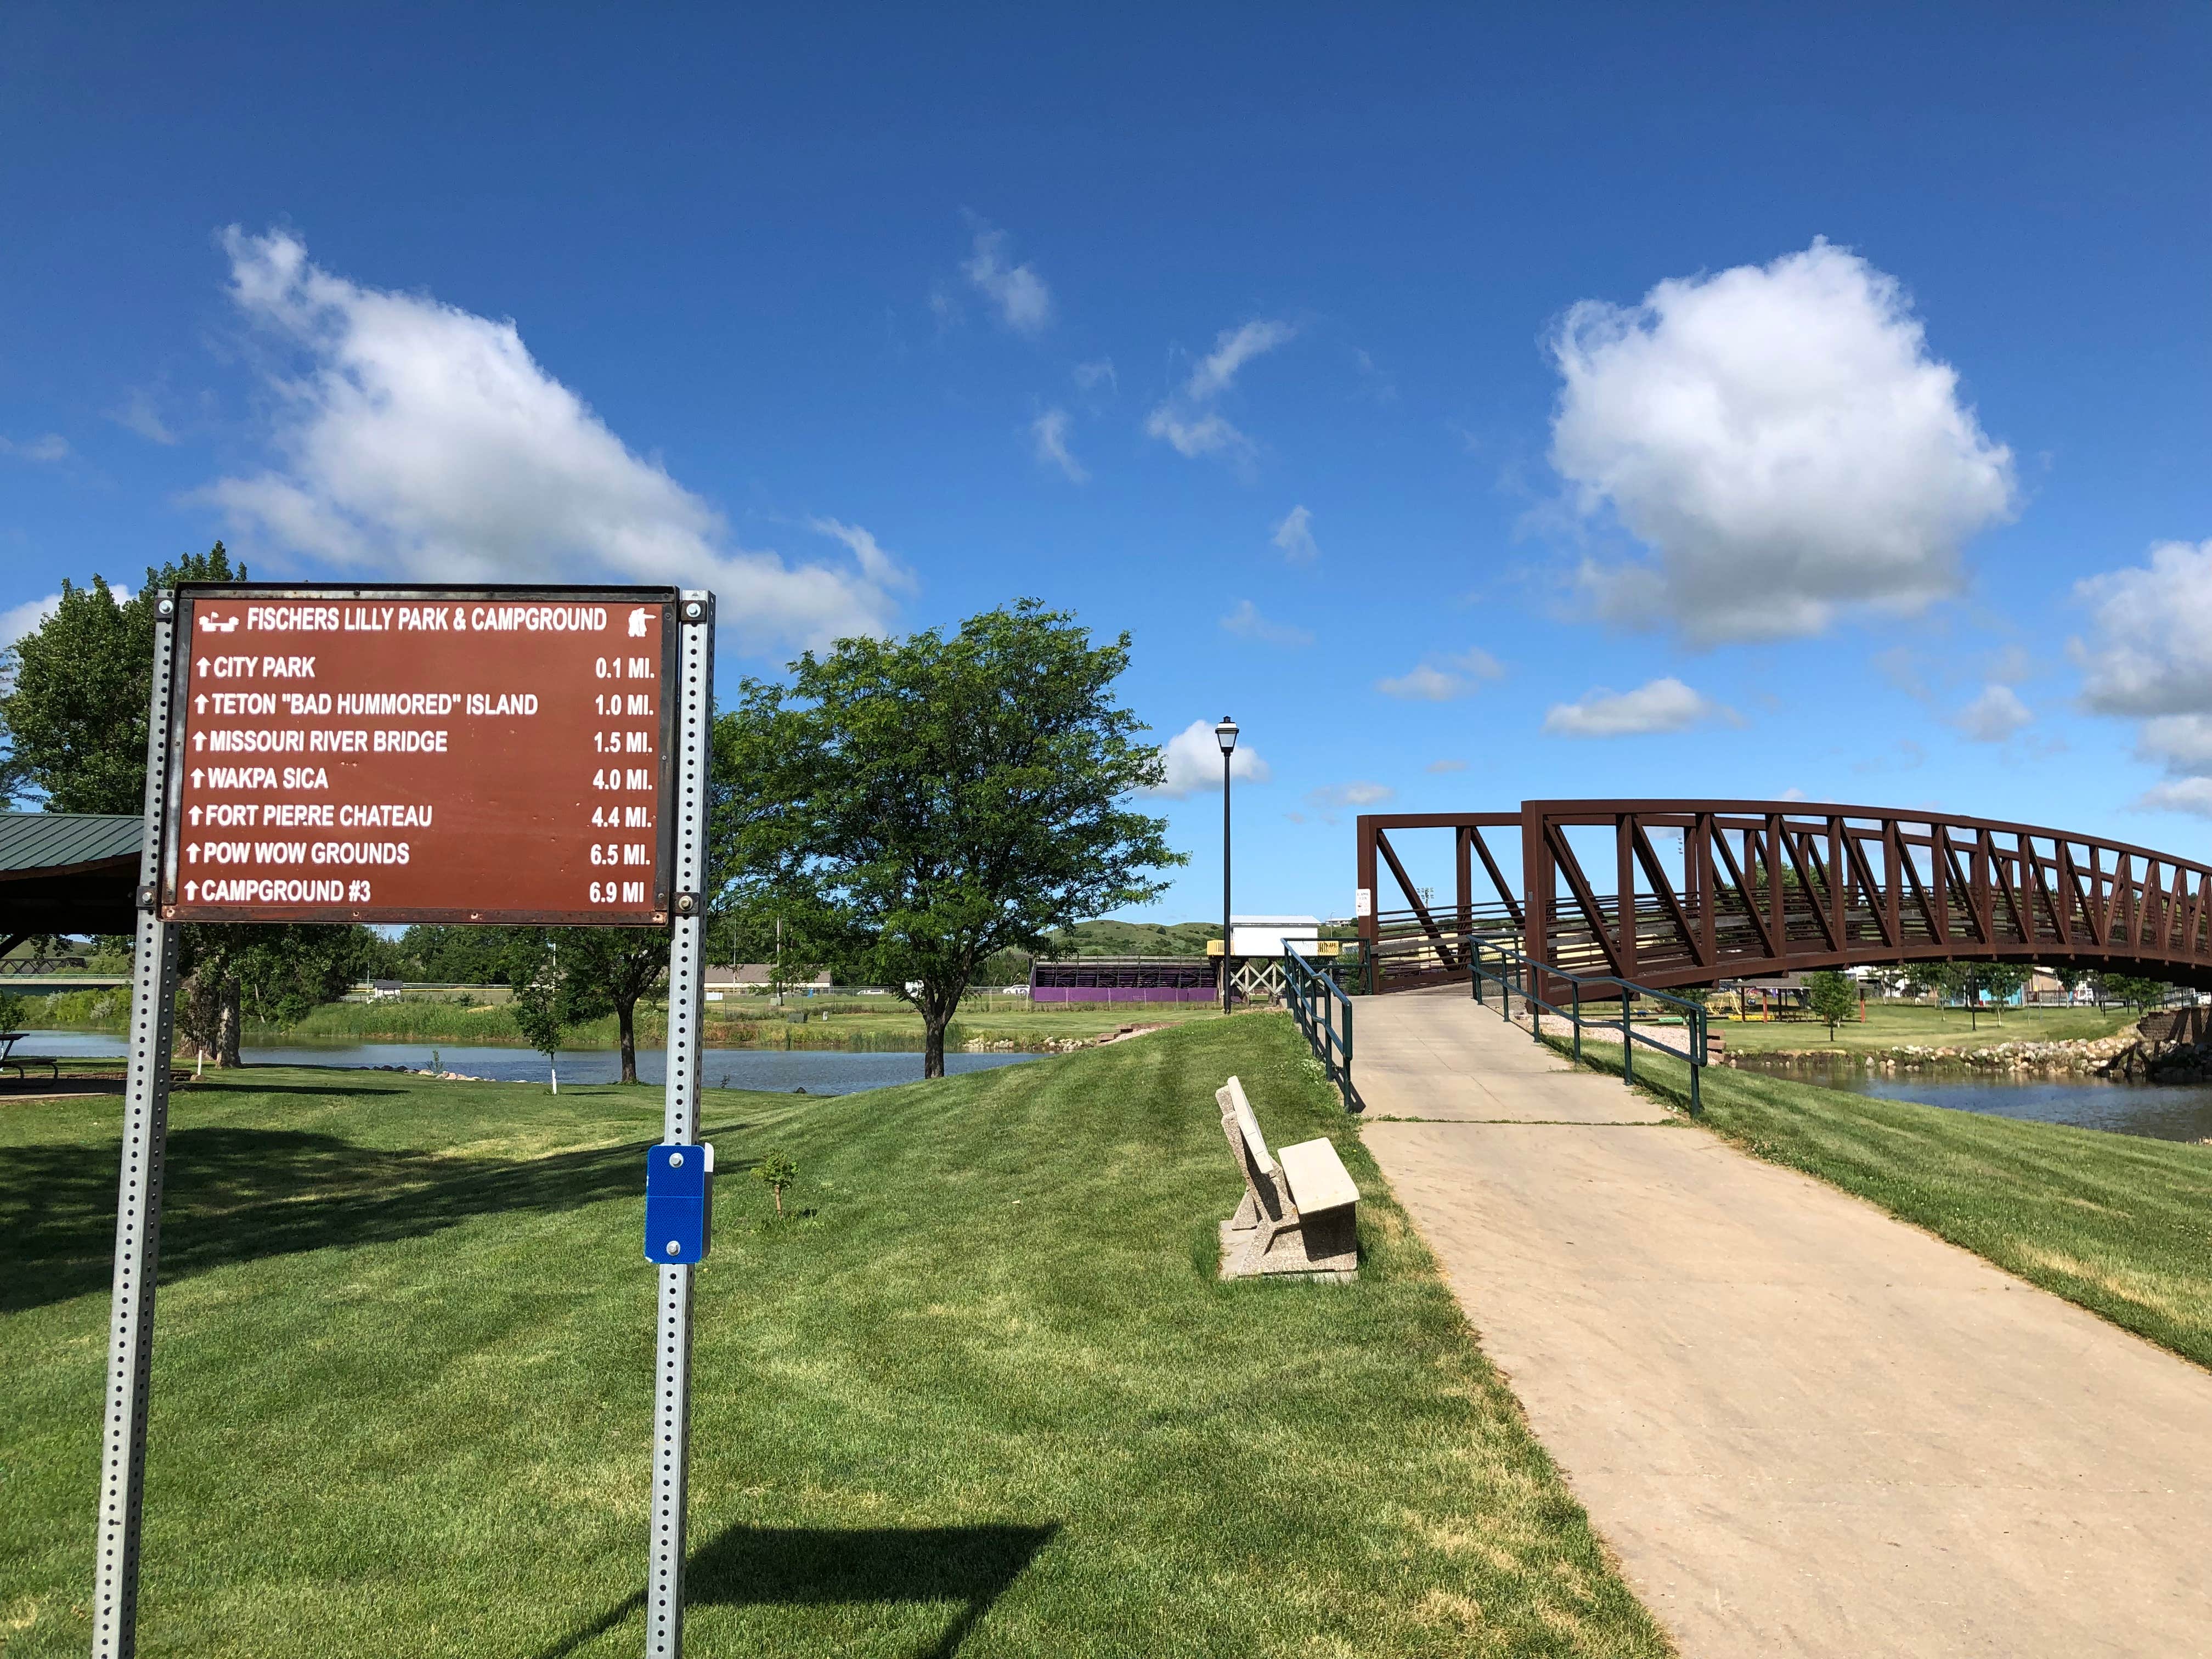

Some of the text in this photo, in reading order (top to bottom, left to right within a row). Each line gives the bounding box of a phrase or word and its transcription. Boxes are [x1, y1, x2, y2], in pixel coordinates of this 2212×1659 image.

[247, 607, 606, 631] FISCHERS LILLY PARK & CAMPGROUND
[214, 656, 655, 678] CITY PARK 0.1 MI.
[212, 693, 654, 715] TETON "BAD HUMMORED" ISLAND 1.0 MI.
[210, 731, 653, 752] MISSOURI RIVER BRIDGE 1.5 MI.
[208, 768, 653, 789] WAKPA SICA 4.0 MI.
[206, 805, 652, 827] FORT PIERRE CHATEAU 4.4 MI.
[204, 842, 650, 865] POW WOW GROUNDS 6.5 MI.
[202, 880, 644, 902] CAMPGROUND #3 6.9 MI
